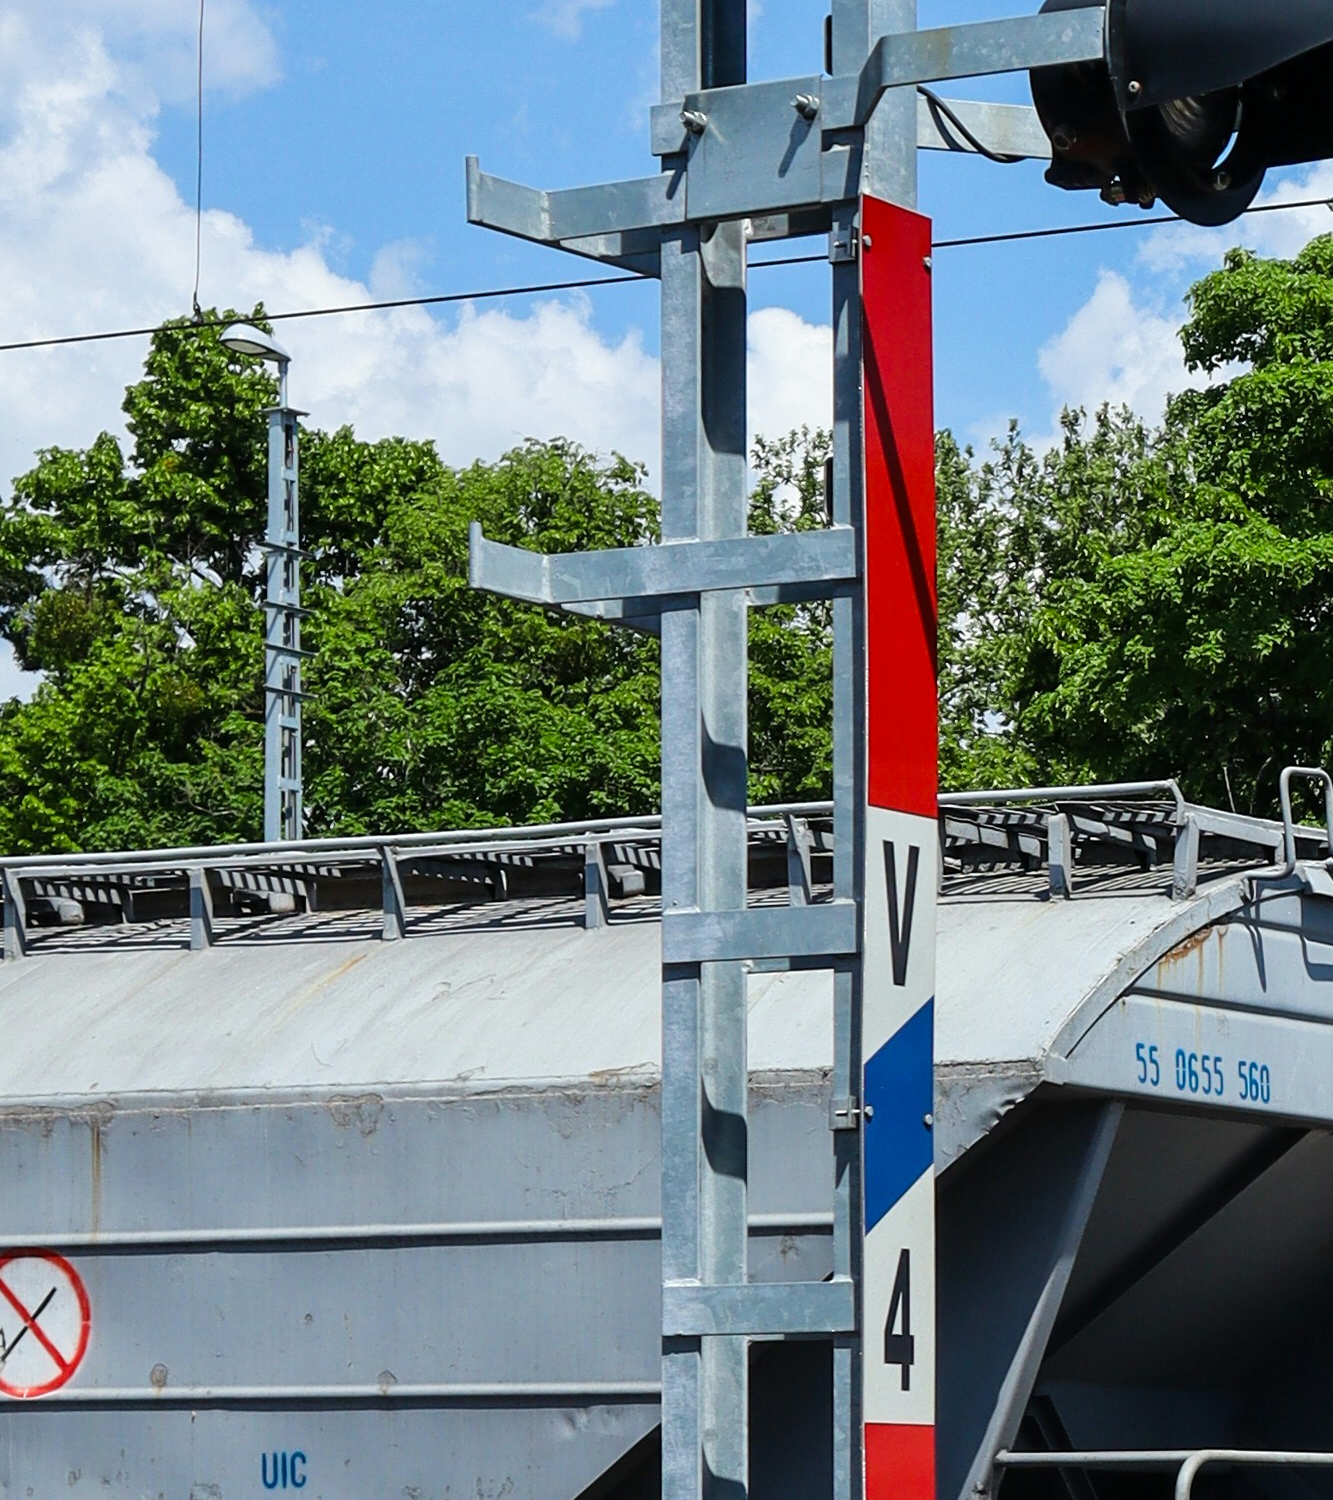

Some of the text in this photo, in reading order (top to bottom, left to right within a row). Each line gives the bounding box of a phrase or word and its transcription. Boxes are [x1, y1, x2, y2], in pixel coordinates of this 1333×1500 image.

[881, 839, 920, 987] V
[1135, 1042, 1271, 1104] 55 0655 560
[883, 1247, 915, 1392] 4
[261, 1450, 307, 1490] UIC
